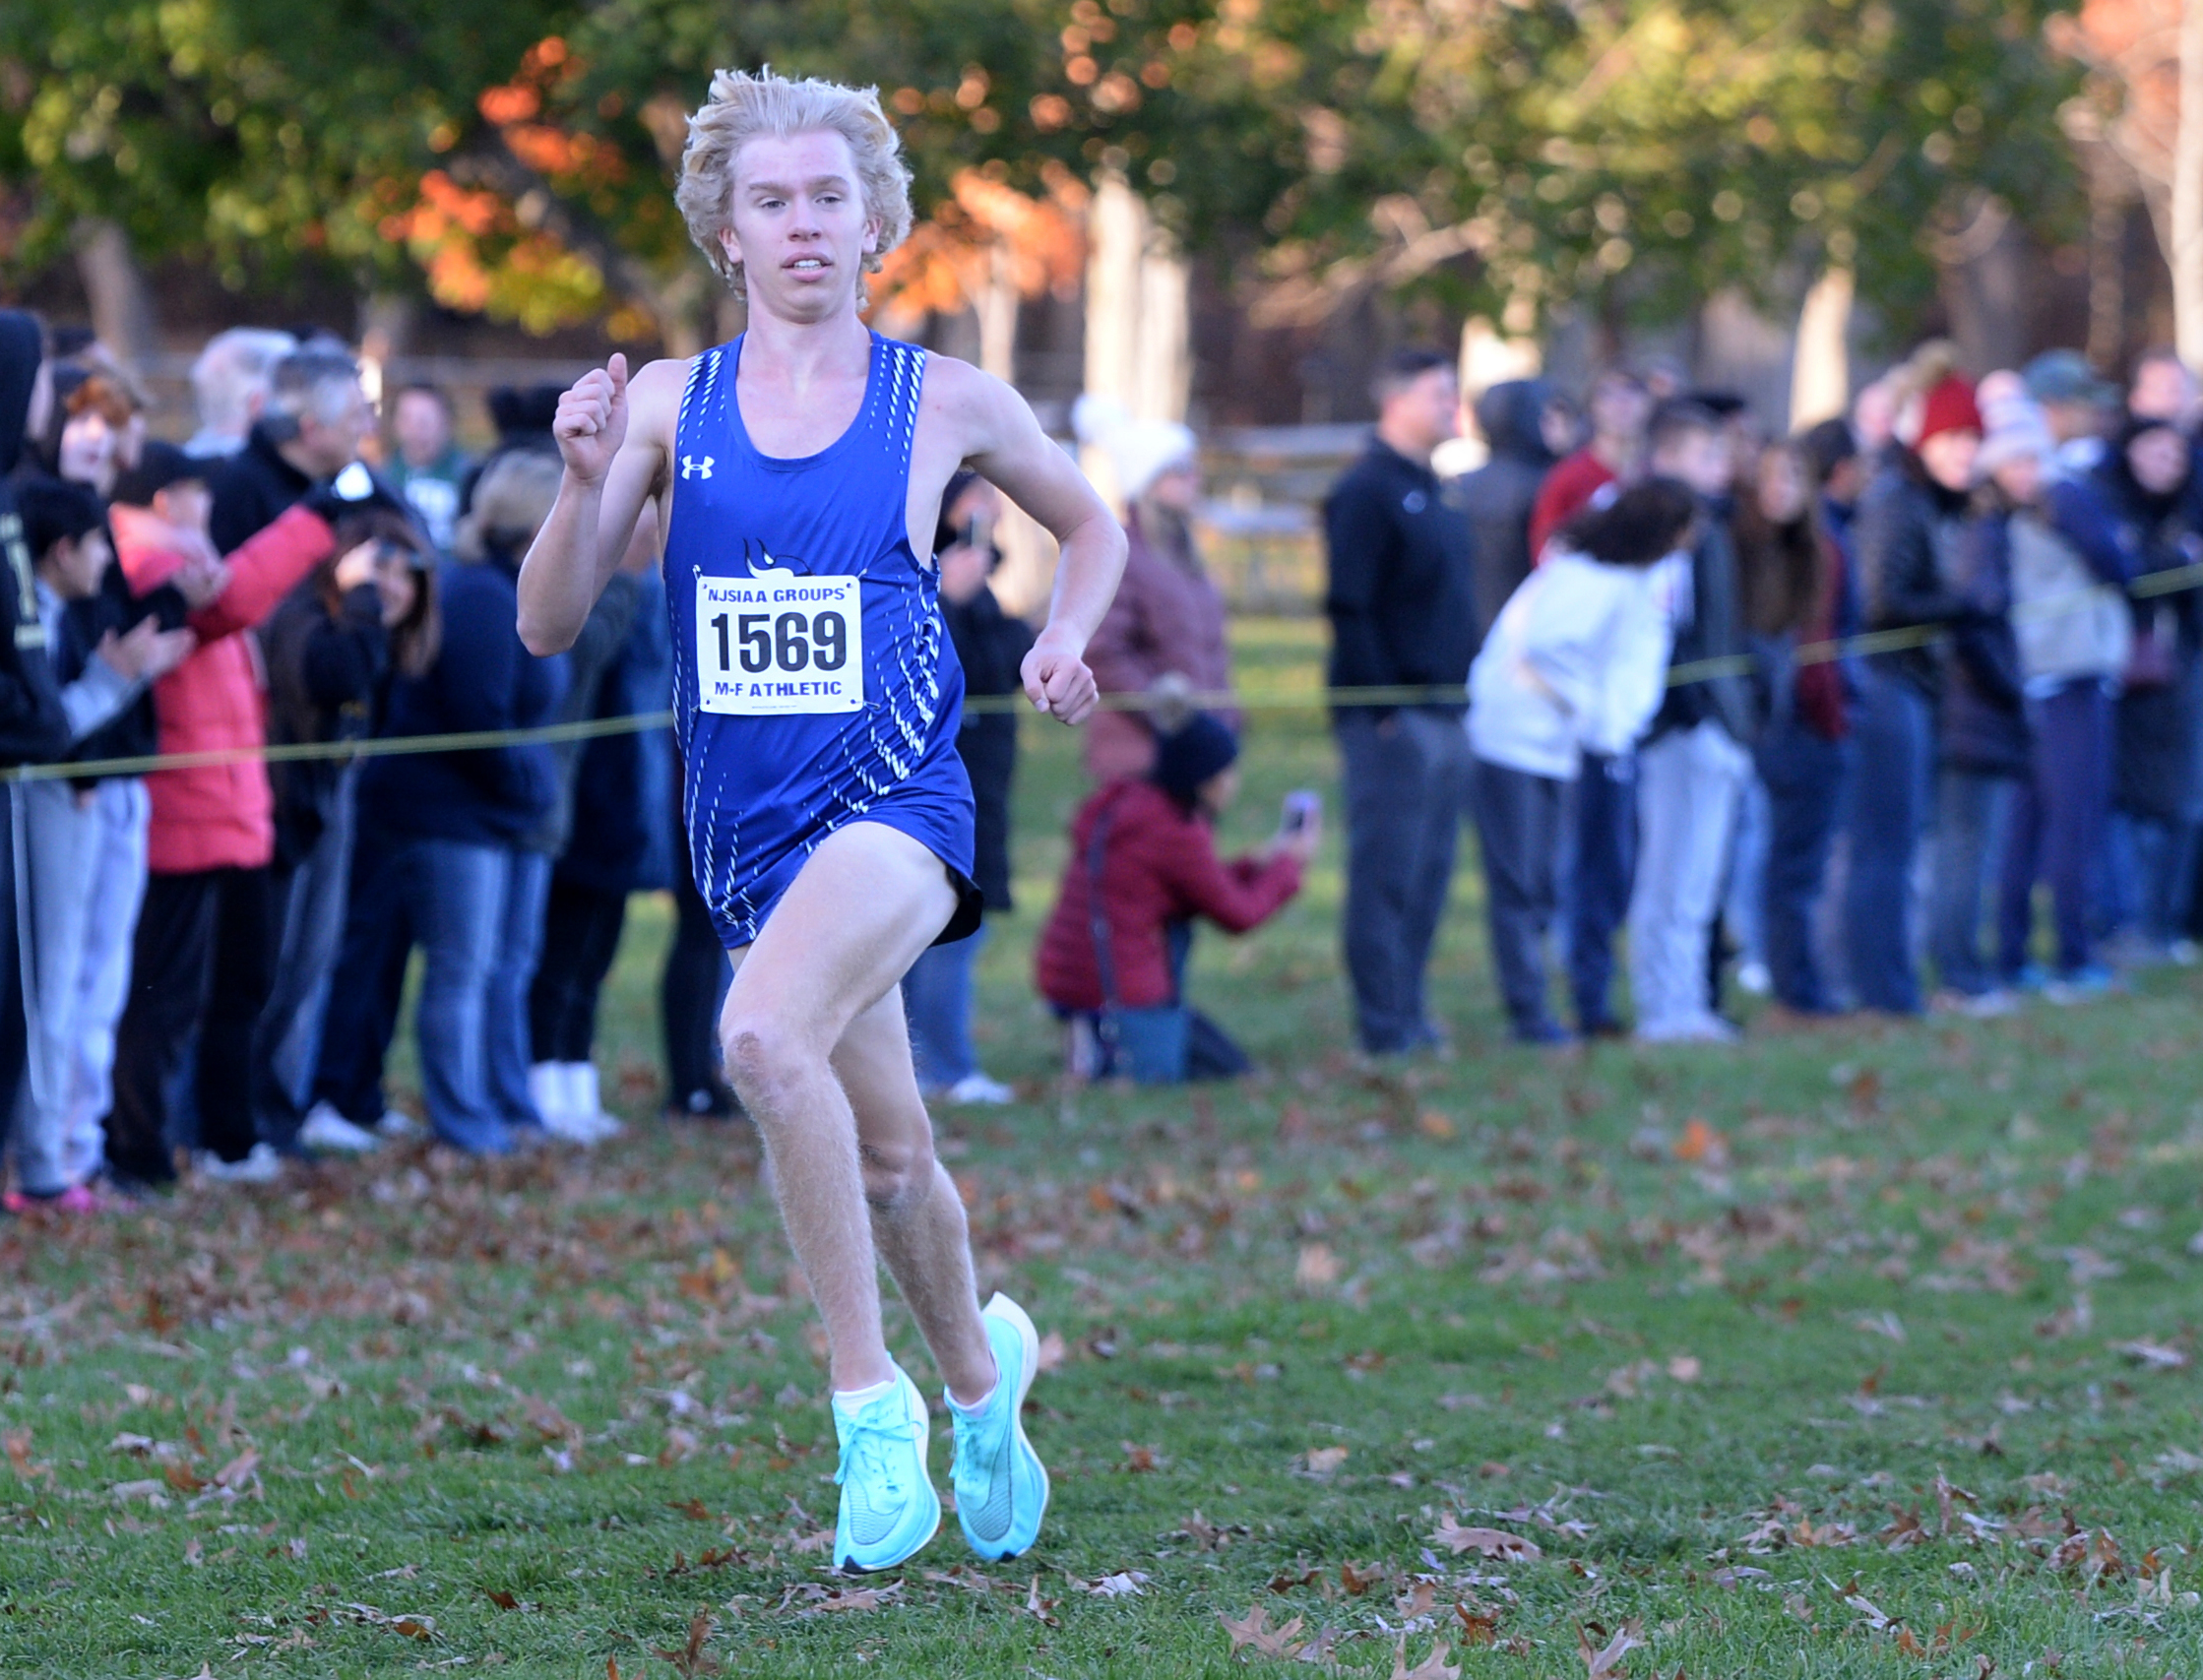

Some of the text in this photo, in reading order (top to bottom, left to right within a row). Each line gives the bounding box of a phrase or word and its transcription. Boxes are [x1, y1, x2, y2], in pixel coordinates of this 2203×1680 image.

[708, 588, 846, 602] NJSIAA GROUPS
[711, 611, 847, 673] 1569
[715, 681, 842, 697] M-F ATHLETIC
